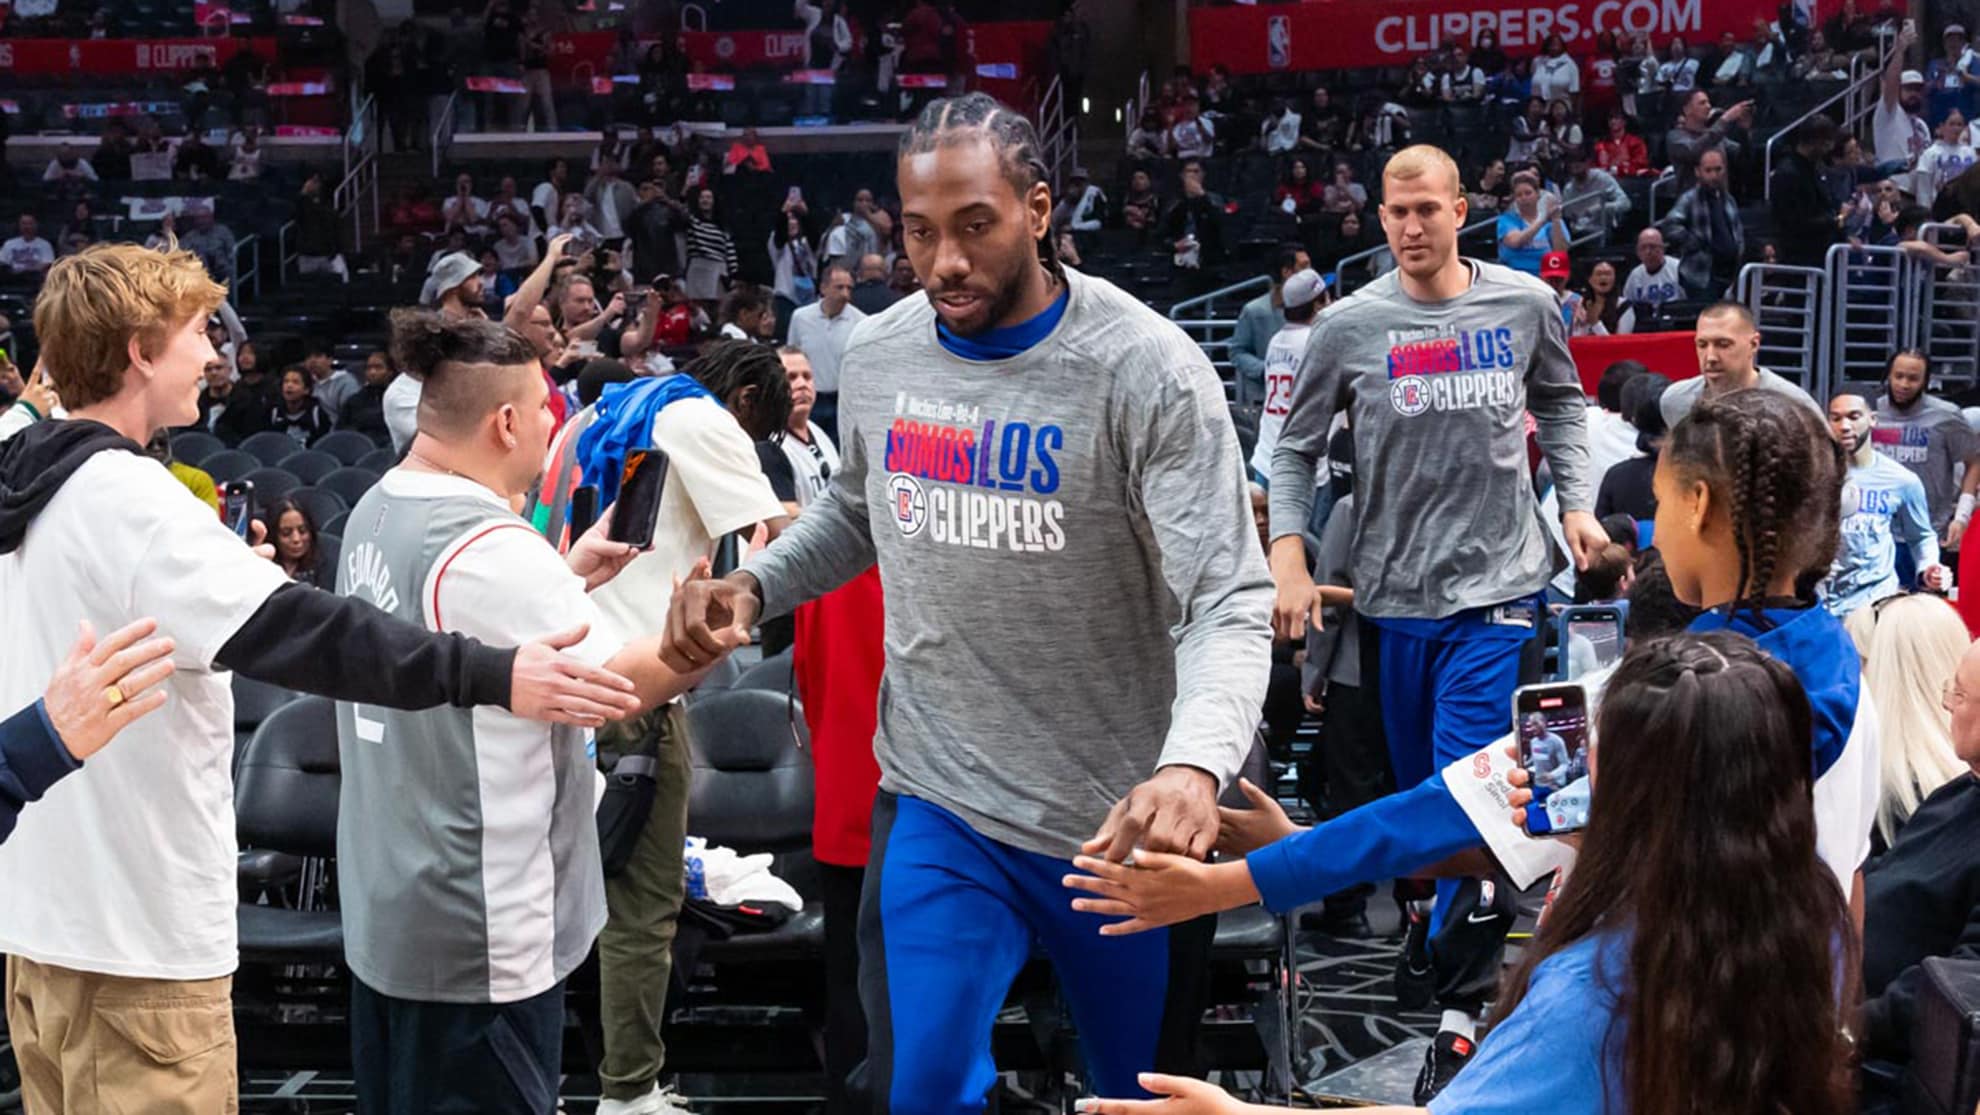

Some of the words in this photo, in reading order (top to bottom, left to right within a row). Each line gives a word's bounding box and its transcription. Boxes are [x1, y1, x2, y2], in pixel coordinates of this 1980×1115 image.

[1374, 0, 1702, 53] CLIPPERS.COM
[1460, 327, 1514, 371] LOS
[1266, 374, 1294, 414] 23
[1432, 371, 1515, 412] CLIPPERS
[888, 417, 975, 485] SOMOS
[977, 419, 1063, 495] LOS
[929, 487, 1066, 552] CLIPPERS
[1856, 487, 1890, 514] LOS
